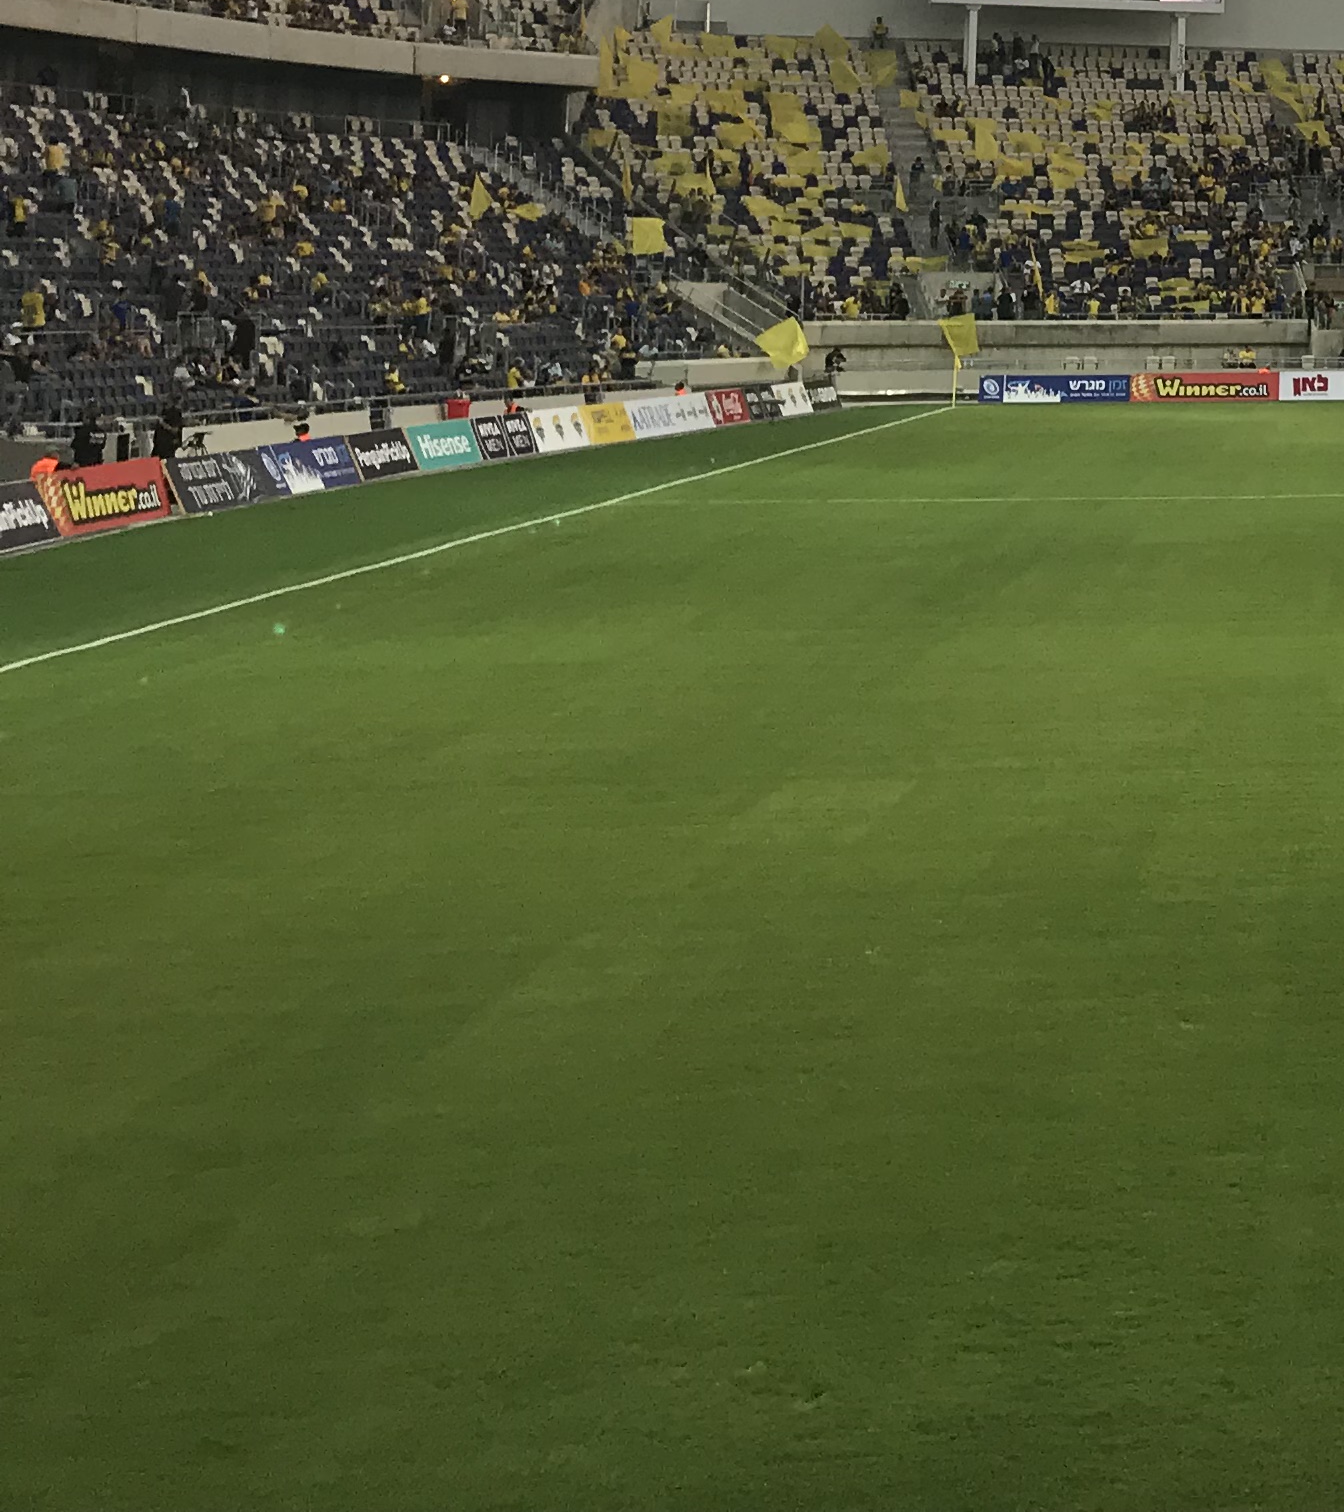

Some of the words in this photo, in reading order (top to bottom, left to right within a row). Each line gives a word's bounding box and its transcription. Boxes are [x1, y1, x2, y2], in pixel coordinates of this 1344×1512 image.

[1069, 380, 1106, 391] מגרש
[1293, 374, 1328, 396] לאן
[417, 434, 471, 459] Hisense
